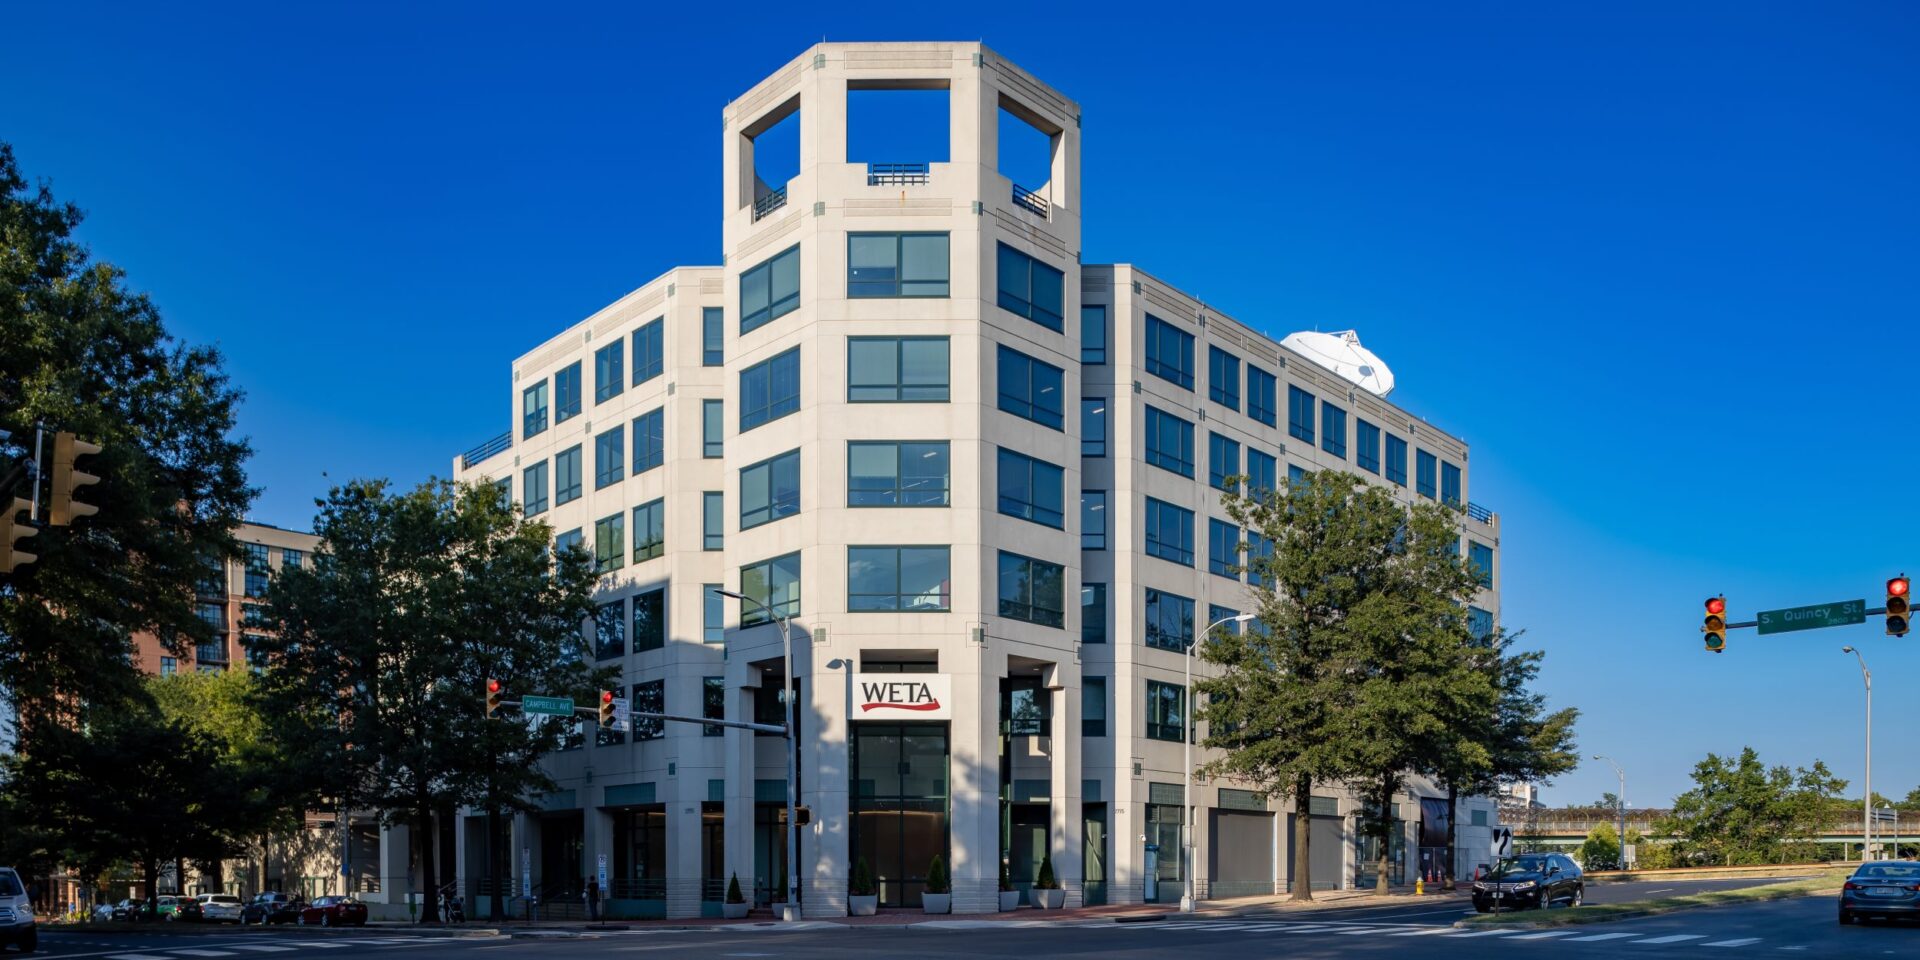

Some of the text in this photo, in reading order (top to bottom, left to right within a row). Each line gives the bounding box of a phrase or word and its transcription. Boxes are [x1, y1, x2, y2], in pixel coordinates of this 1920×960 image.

[1761, 602, 1863, 624] S. Quincy St.
[861, 682, 934, 703] WETA
[525, 699, 571, 712] CAMPBELL AVE
